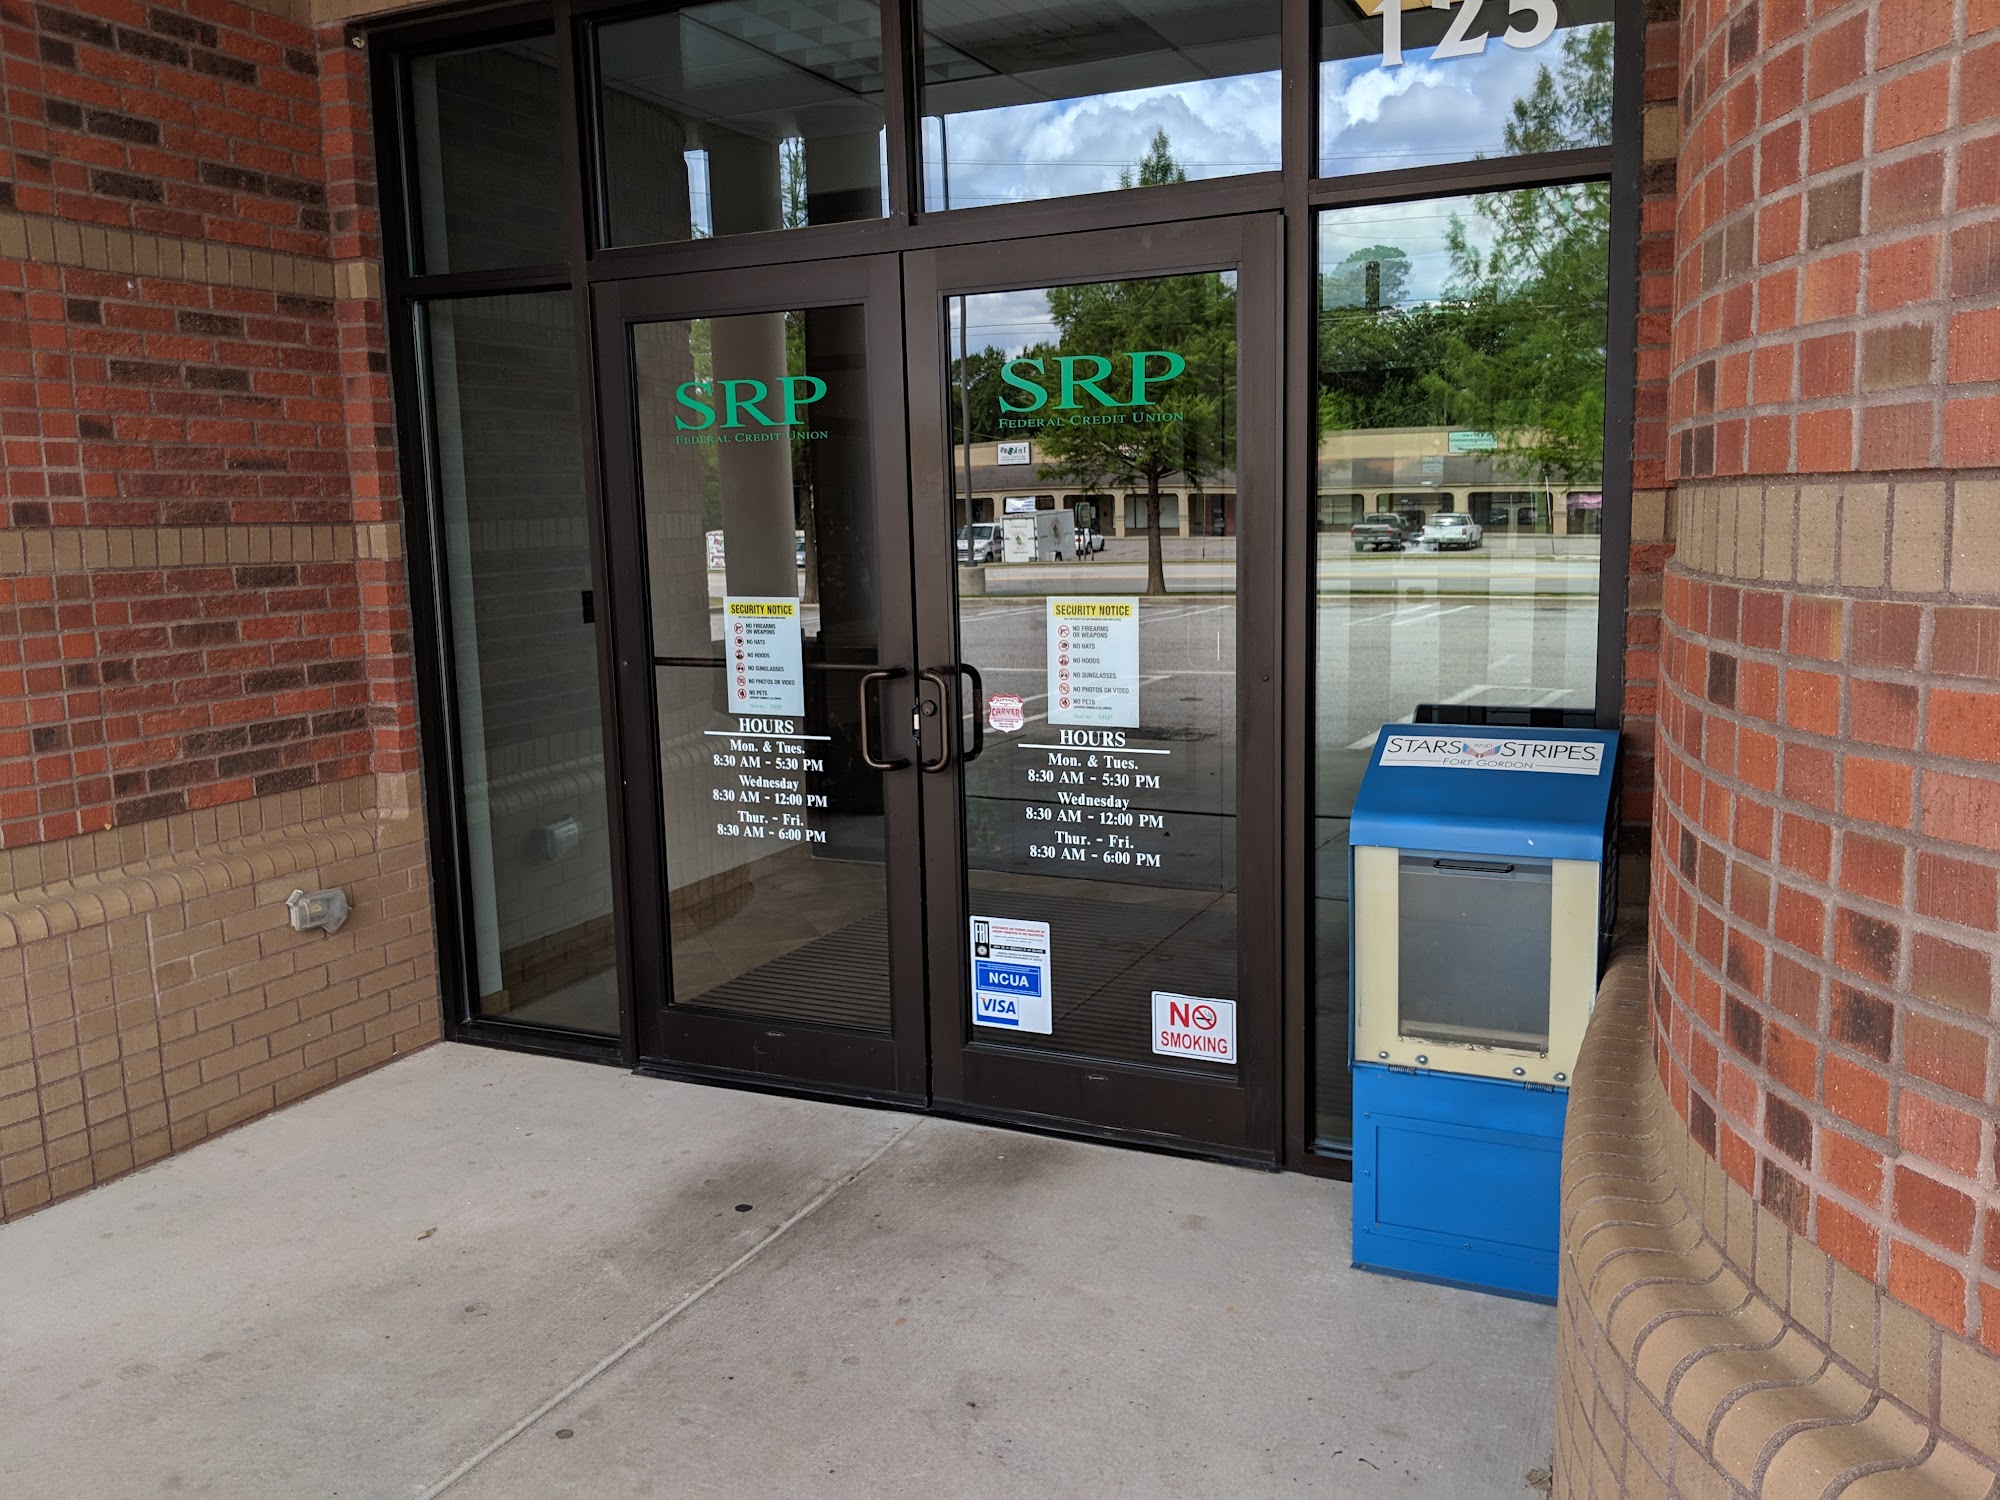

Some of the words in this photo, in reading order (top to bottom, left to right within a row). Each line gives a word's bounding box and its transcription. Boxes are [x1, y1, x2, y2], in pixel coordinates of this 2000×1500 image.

[1372, 0, 1558, 67] 125
[999, 351, 1185, 413] SRP
[674, 376, 827, 430] SRP
[731, 604, 764, 614] SECURITY
[767, 605, 792, 614] NOTICE
[1056, 605, 1096, 615] SECURITY
[1100, 605, 1130, 616] NOTICE
[992, 708, 1020, 717] CARVER
[739, 718, 794, 734] HOURS
[730, 739, 758, 752] Mon.
[763, 741, 772, 752] &
[776, 741, 805, 754] Tues.
[1059, 729, 1126, 747] HOURS
[1387, 738, 1462, 755] STARS
[713, 754, 736, 766] 8:30
[740, 756, 761, 768] AM
[775, 758, 798, 770] 5:30
[803, 759, 824, 772] PM
[1048, 753, 1082, 767] Mon.
[1087, 755, 1098, 768] &
[1104, 755, 1138, 770] Tues.
[1442, 758, 1472, 766] FORT
[1476, 760, 1534, 769] GORDON
[739, 775, 799, 792] Wednesday
[1028, 769, 1054, 782] 8:30
[1059, 771, 1084, 784] AM
[1102, 773, 1129, 787] 5:30
[1135, 775, 1160, 789] PM
[713, 789, 735, 801] 8:30
[739, 791, 760, 803] AM
[775, 793, 802, 806] 12:00
[807, 795, 828, 808] PM
[1057, 792, 1130, 810] Wednesday
[738, 811, 768, 824] Thur.
[783, 814, 804, 826] Fri.
[1026, 807, 1052, 820] 8:30
[1057, 809, 1082, 823] AM
[1100, 812, 1133, 826] 12:00
[1139, 814, 1164, 828] PM
[717, 824, 739, 836] 8:30
[743, 826, 764, 838] AM
[778, 828, 801, 840] 6:00
[805, 830, 826, 843] PM
[1055, 831, 1091, 845] Thur.
[1109, 834, 1134, 849] Fri.
[1030, 845, 1056, 858] 8:30
[1061, 848, 1086, 861] AM
[1103, 851, 1130, 864] 6:00
[1136, 853, 1161, 867] PM
[975, 922, 988, 944] FBI
[989, 972, 1029, 988] NCUA
[979, 997, 1016, 1014] VISA
[1161, 1031, 1228, 1054] SMOKING
